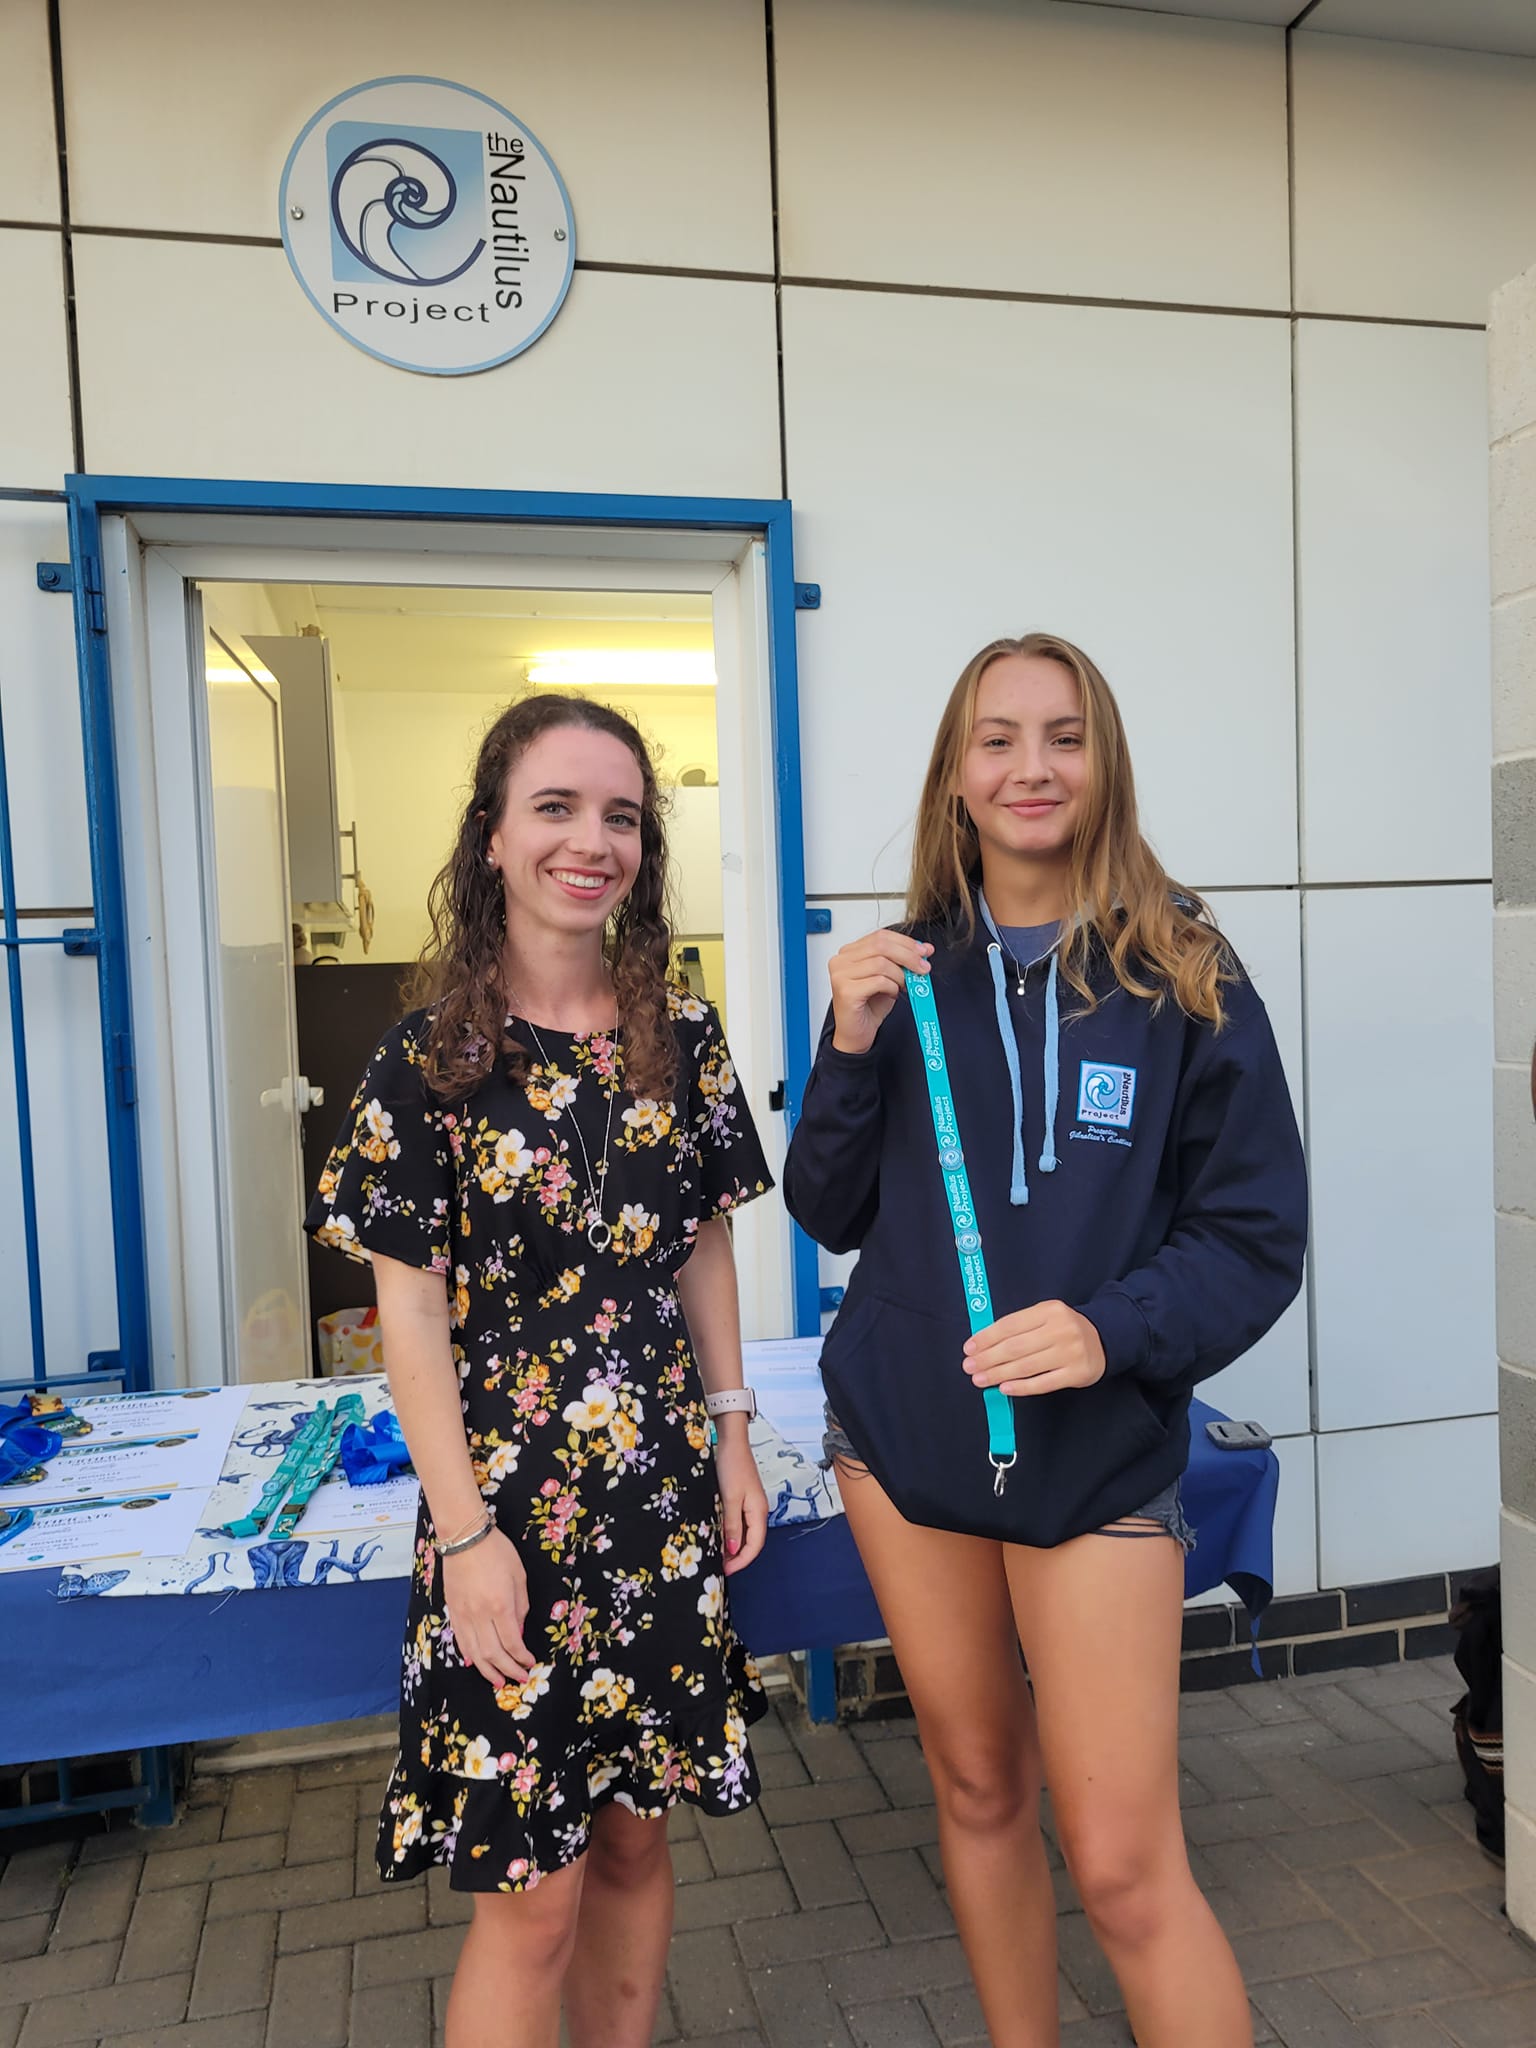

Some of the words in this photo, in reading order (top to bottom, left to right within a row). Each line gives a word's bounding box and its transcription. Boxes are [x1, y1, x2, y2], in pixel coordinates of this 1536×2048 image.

[486, 132, 524, 153] the
[489, 152, 530, 310] Nautilus
[333, 292, 491, 324] Project
[929, 1021, 941, 1056] Project
[942, 1096, 955, 1132] Project
[1081, 1109, 1119, 1120] Project
[957, 1174, 970, 1212] Project
[972, 1254, 986, 1294] Project
